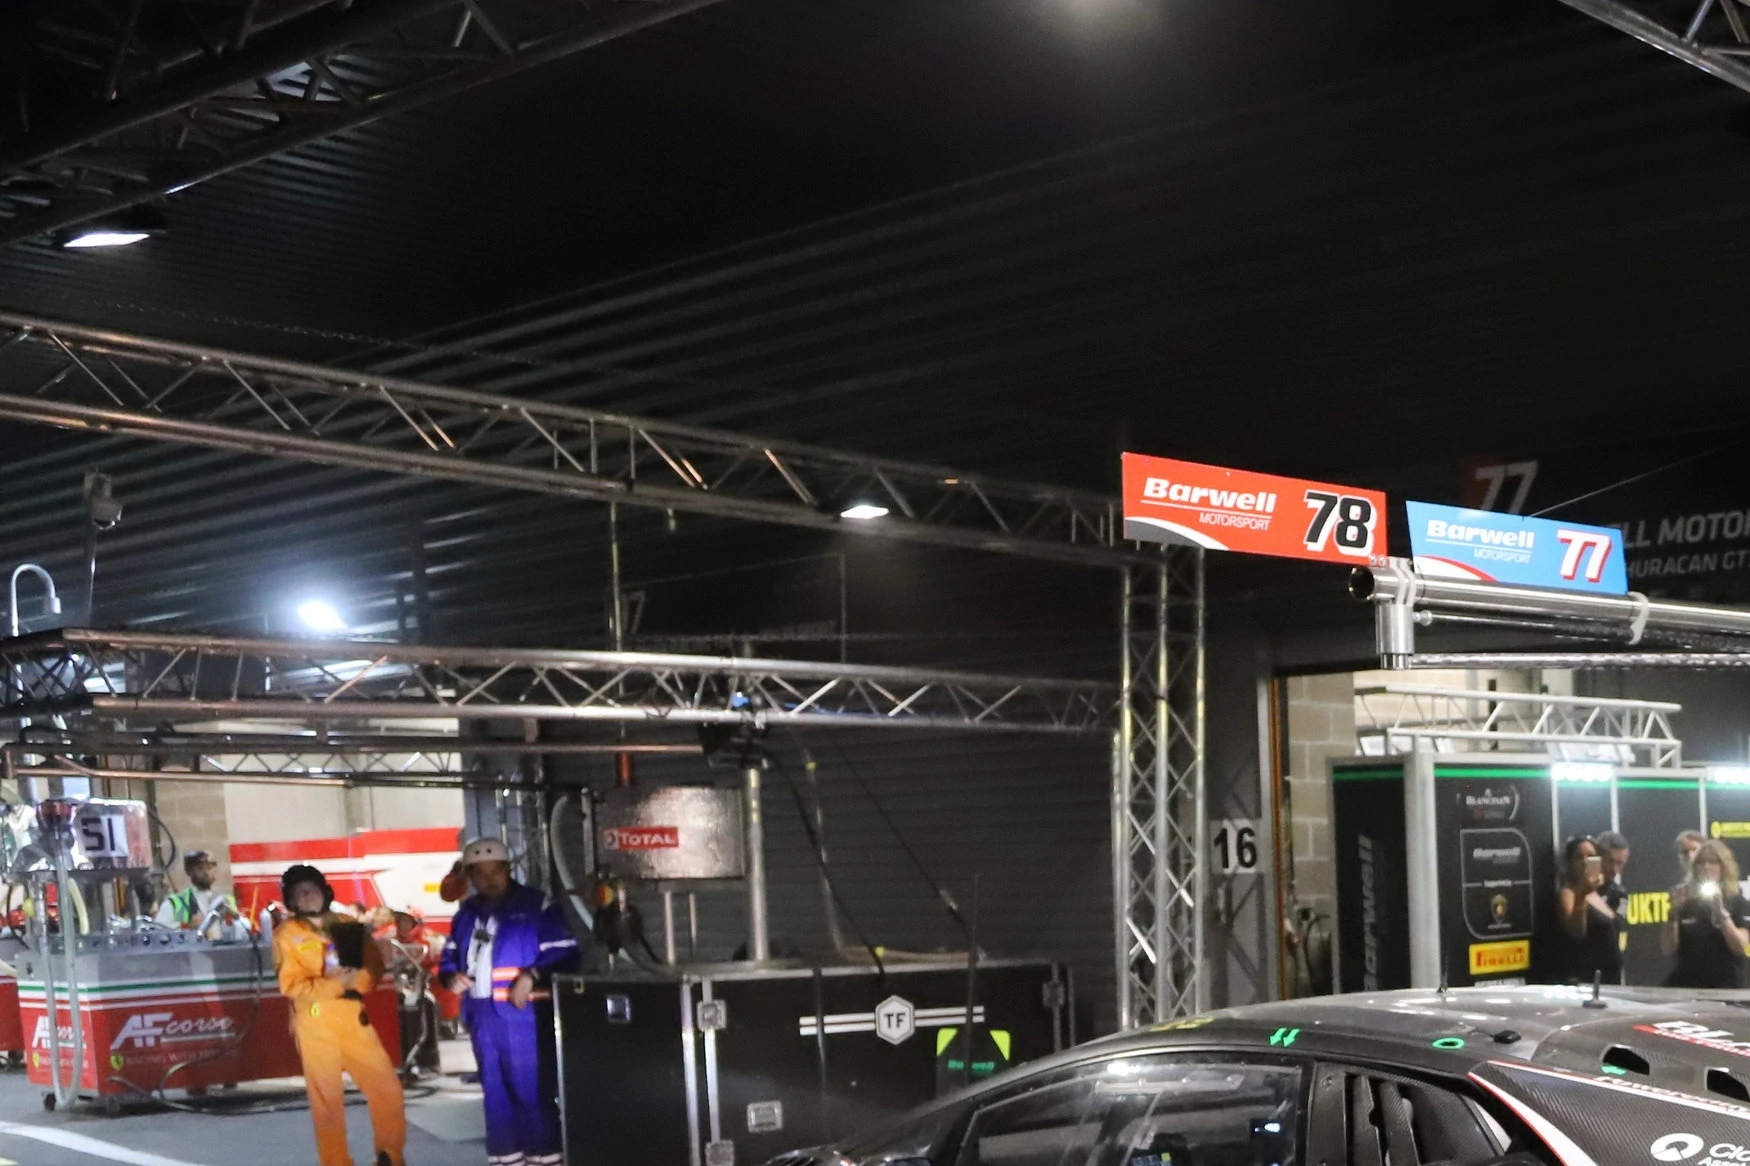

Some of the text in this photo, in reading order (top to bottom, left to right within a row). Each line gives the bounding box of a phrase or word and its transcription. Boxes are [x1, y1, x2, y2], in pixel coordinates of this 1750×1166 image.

[1143, 476, 1377, 557] Barwell 78
[1199, 512, 1273, 531] MOTORSPORT
[1427, 519, 1613, 583] Barwell 77
[1474, 547, 1532, 565] MOTORSPORT
[619, 832, 675, 847] TOTAL
[1212, 826, 1258, 869] 16
[110, 1012, 174, 1051] AF
[882, 1012, 906, 1029] TF
